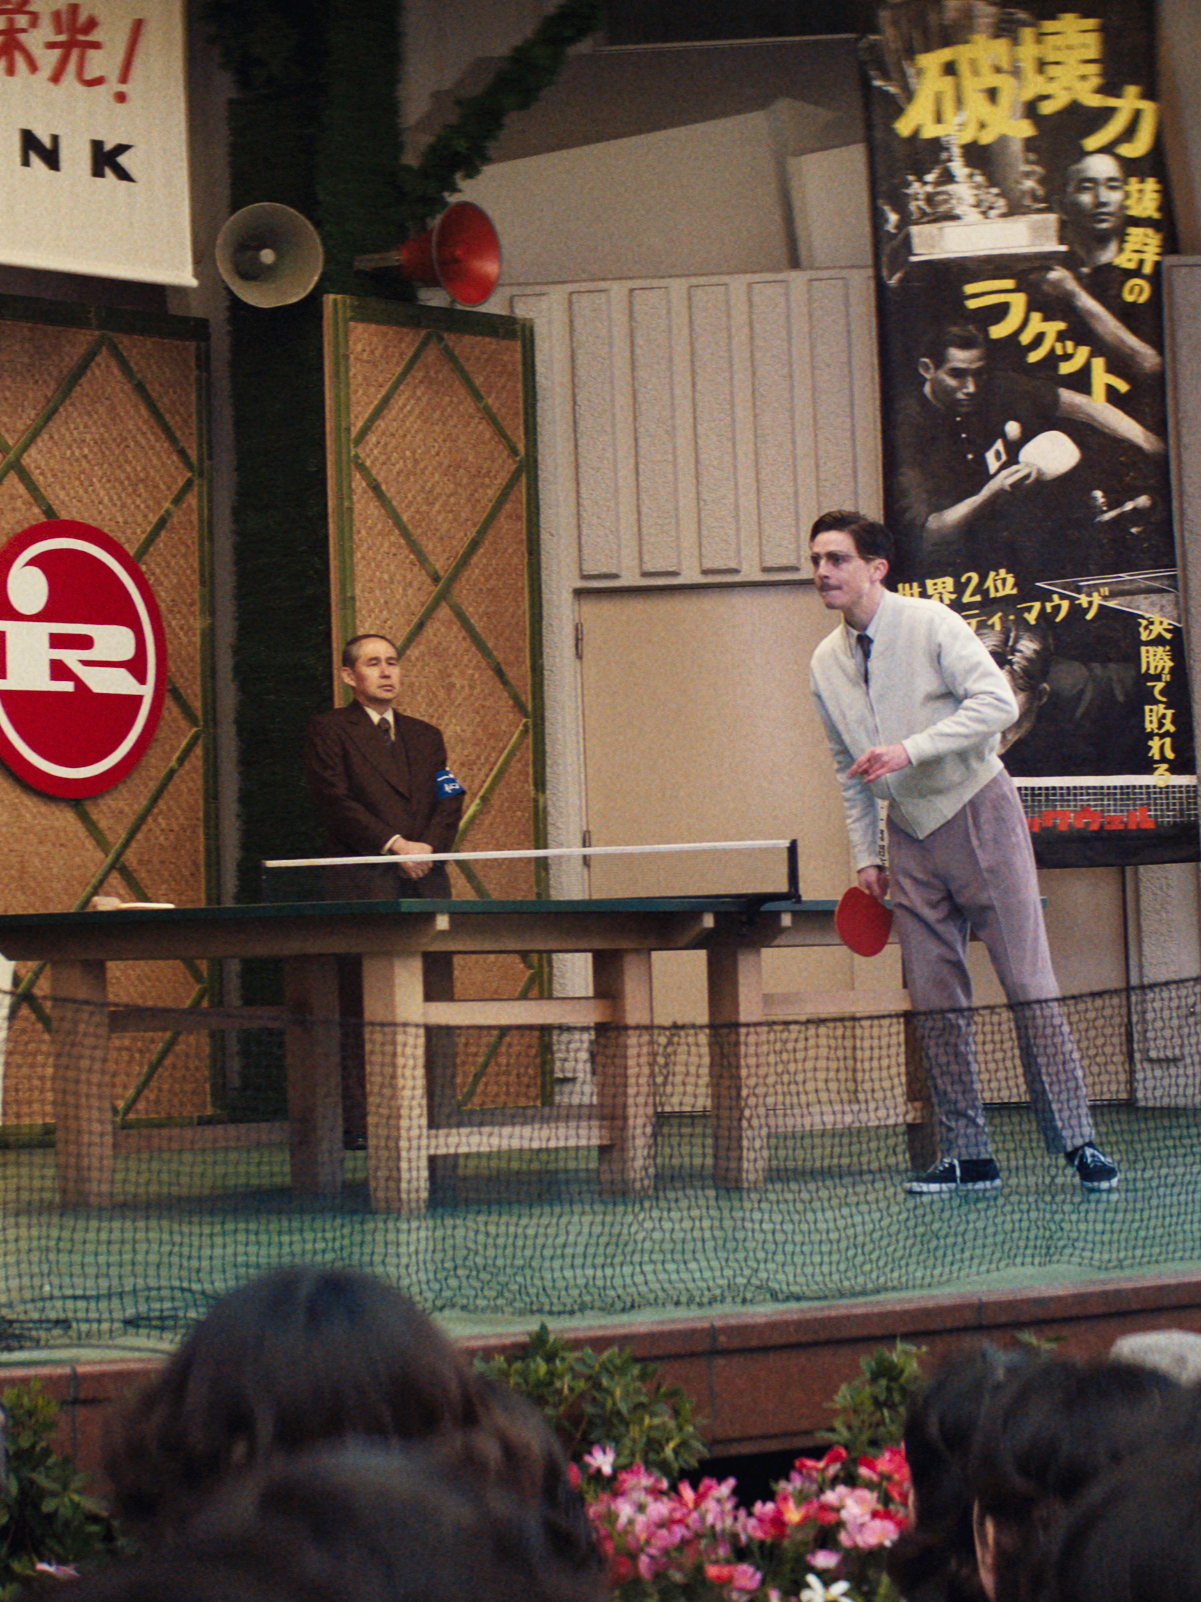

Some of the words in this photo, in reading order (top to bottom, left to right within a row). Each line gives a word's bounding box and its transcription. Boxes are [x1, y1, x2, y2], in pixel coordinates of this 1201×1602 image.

[894, 13, 1158, 158] 破壊力
[1111, 177, 1162, 304] 抜群の
[963, 278, 1132, 404] ラケット
[1137, 613, 1177, 788] 決勝で敗れる
